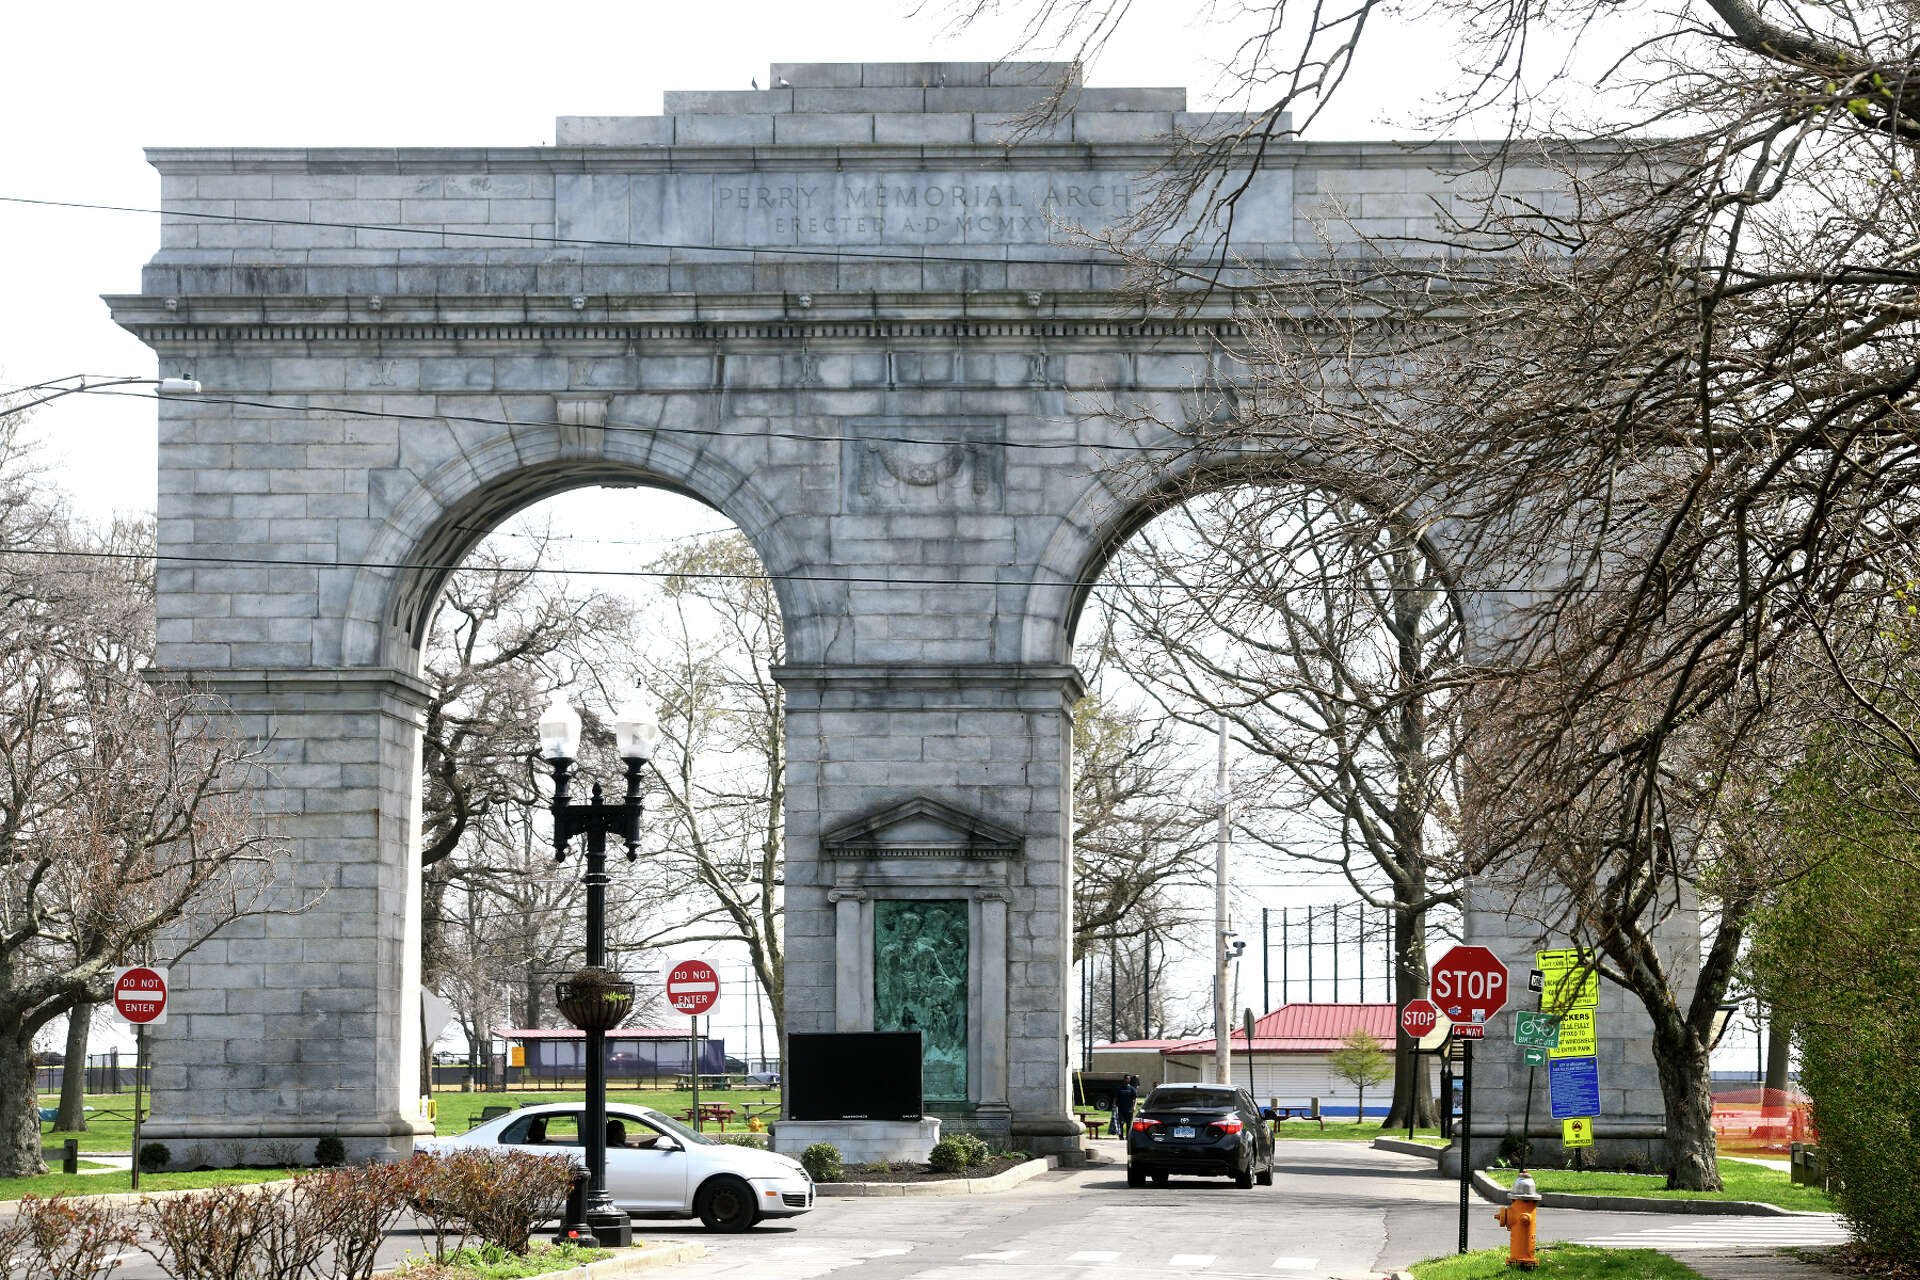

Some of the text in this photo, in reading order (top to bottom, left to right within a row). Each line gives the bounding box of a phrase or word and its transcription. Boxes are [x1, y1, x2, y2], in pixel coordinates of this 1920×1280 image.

[718, 185, 1130, 208] PERRY MEMORIAL ARCH
[775, 217, 887, 233] ERECTED
[674, 970, 711, 980] DO NOT
[123, 978, 159, 988] DO NOT
[1435, 970, 1503, 1000] STOP
[678, 994, 708, 1005] ENTER
[125, 1003, 155, 1012] ENTER
[1404, 1011, 1435, 1026] STOP
[1455, 1027, 1481, 1037] 4-WAY
[1518, 1036, 1533, 1044] BIKE
[1535, 1038, 1555, 1046] ROUTE
